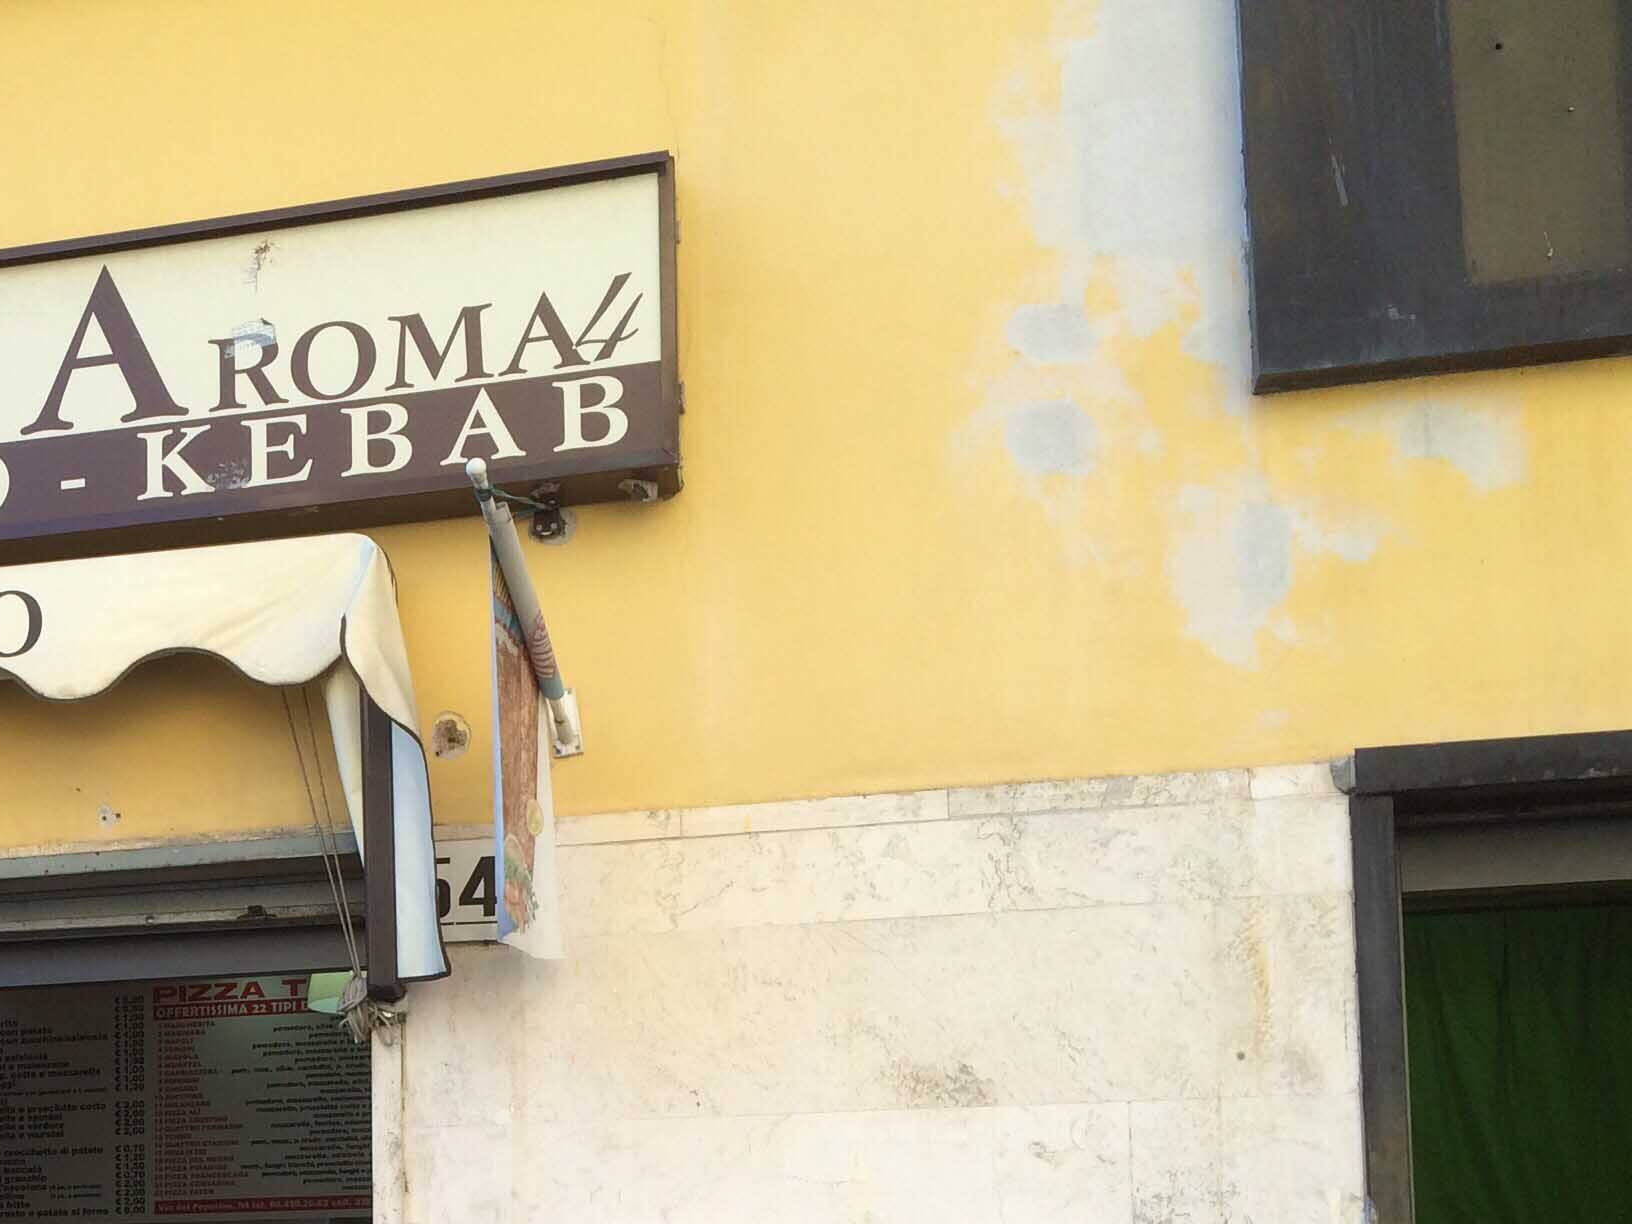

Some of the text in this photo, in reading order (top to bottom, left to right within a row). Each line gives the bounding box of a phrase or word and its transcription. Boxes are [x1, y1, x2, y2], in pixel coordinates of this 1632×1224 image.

[137, 375, 631, 500] KEBAB
[153, 981, 266, 1003] PIZZA
[156, 1002, 248, 1018] OFFERTISSIMA
[252, 1002, 267, 1013] 22
[272, 1001, 297, 1013] TIPI
